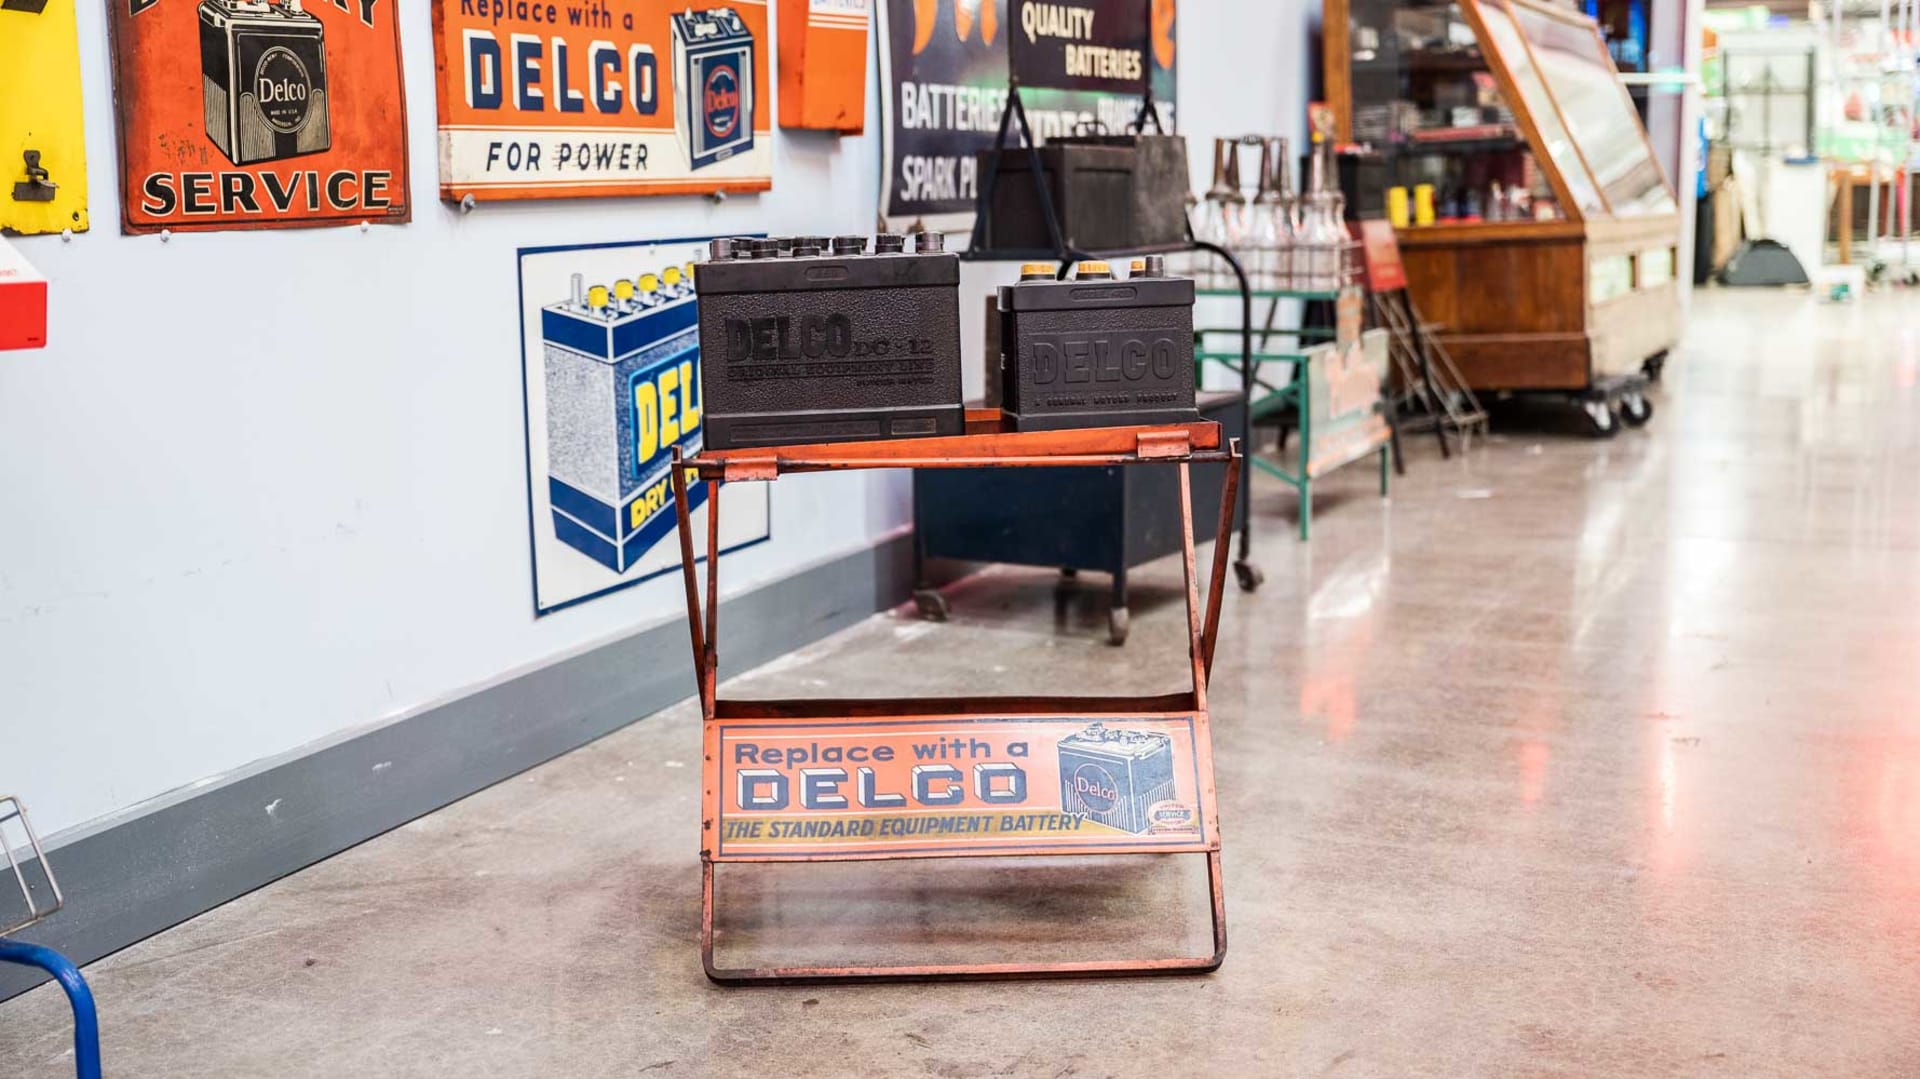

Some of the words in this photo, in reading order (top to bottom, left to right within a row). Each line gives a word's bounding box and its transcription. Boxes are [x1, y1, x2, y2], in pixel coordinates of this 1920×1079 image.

[461, 0, 557, 26] Replace
[567, 0, 612, 29] with
[623, 13, 633, 31] a
[1022, 2, 1095, 43] QUALITY
[463, 28, 658, 116] DELCO
[1065, 44, 1142, 80] BATTERIES
[259, 78, 306, 103] Delco
[486, 142, 541, 171] FOR
[556, 144, 648, 170] POWER
[900, 155, 957, 201] SPARK
[142, 170, 392, 216] SERVICE
[725, 312, 851, 361] DELCO
[1033, 338, 1177, 384] DELCO
[635, 350, 703, 464] DEL
[631, 478, 668, 529] DRY
[735, 742, 895, 768] Replace
[912, 738, 990, 757] with
[1007, 742, 1029, 756] a
[736, 763, 1027, 810] DELCO
[1077, 777, 1115, 799] Delco
[727, 821, 762, 838] THE
[769, 820, 874, 838] STANDARD
[880, 816, 994, 835] EQUIPMENT
[1000, 813, 1086, 832] BATTERY
